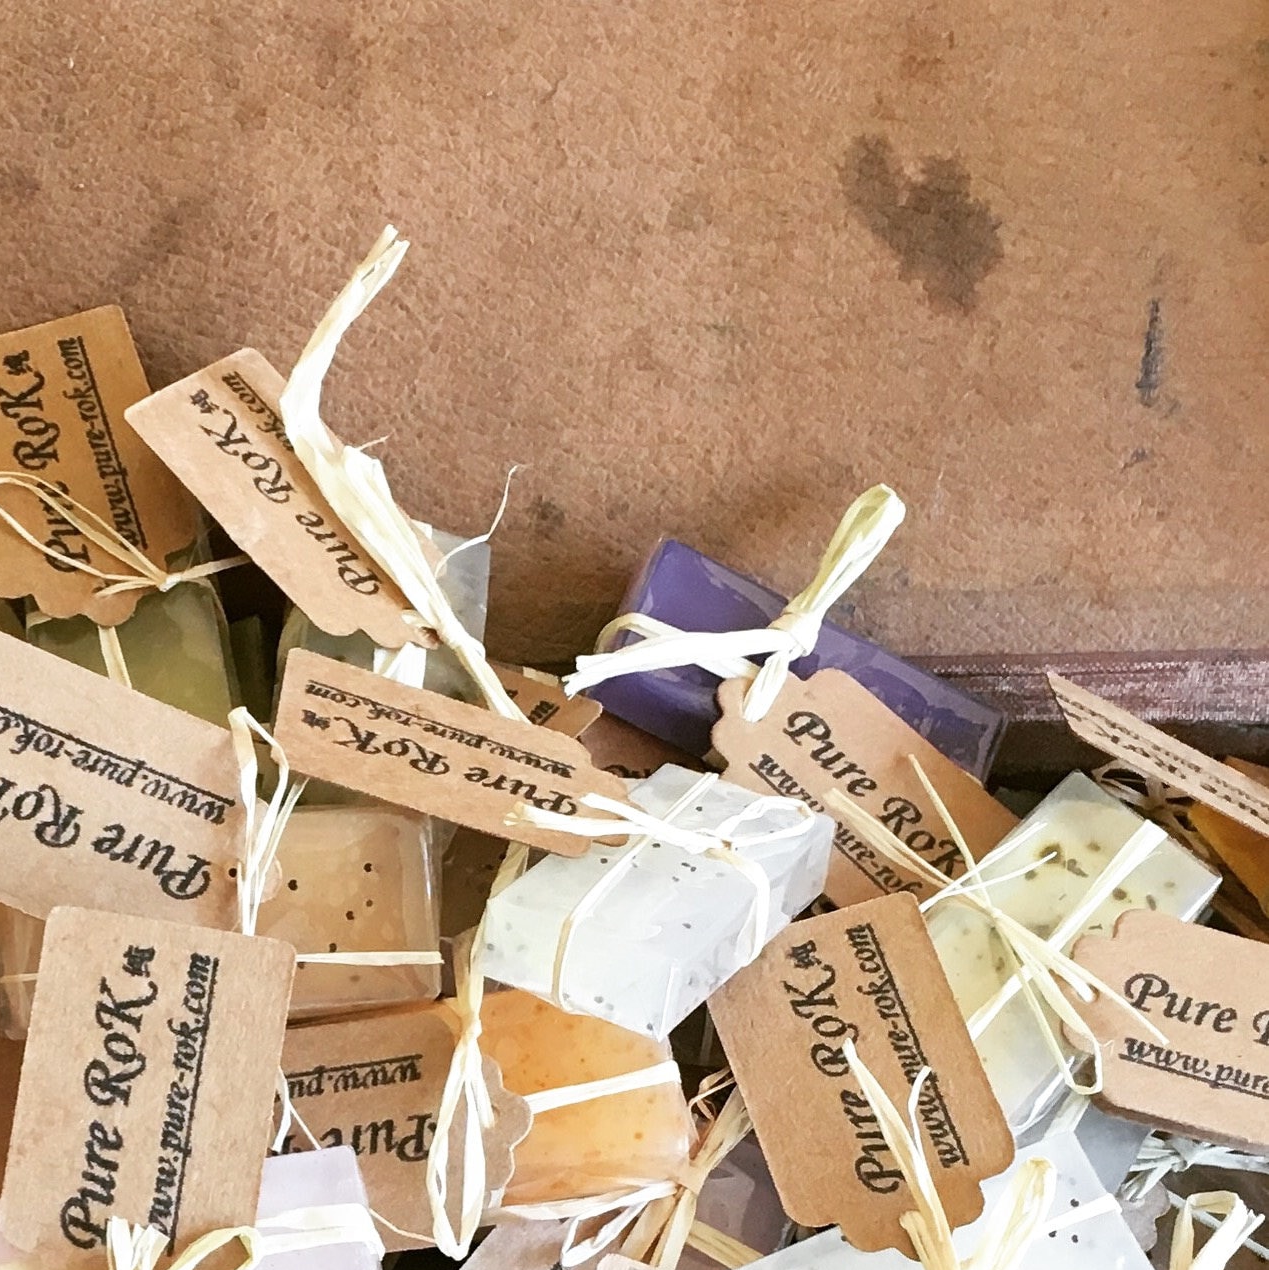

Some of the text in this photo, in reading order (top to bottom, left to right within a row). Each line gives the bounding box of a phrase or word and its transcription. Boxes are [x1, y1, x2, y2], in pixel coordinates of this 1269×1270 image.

[198, 408, 297, 503] RoK
[296, 511, 382, 596] Pure
[305, 679, 576, 778] www.pure-rok.com
[333, 718, 577, 818] Pure RoK
[783, 710, 877, 797] Pure
[91, 822, 212, 900] Pure
[84, 977, 158, 1106] RoK
[1124, 973, 1238, 1033] Pure
[781, 964, 907, 1194] Pure RoK
[60, 1121, 123, 1250] Pure
